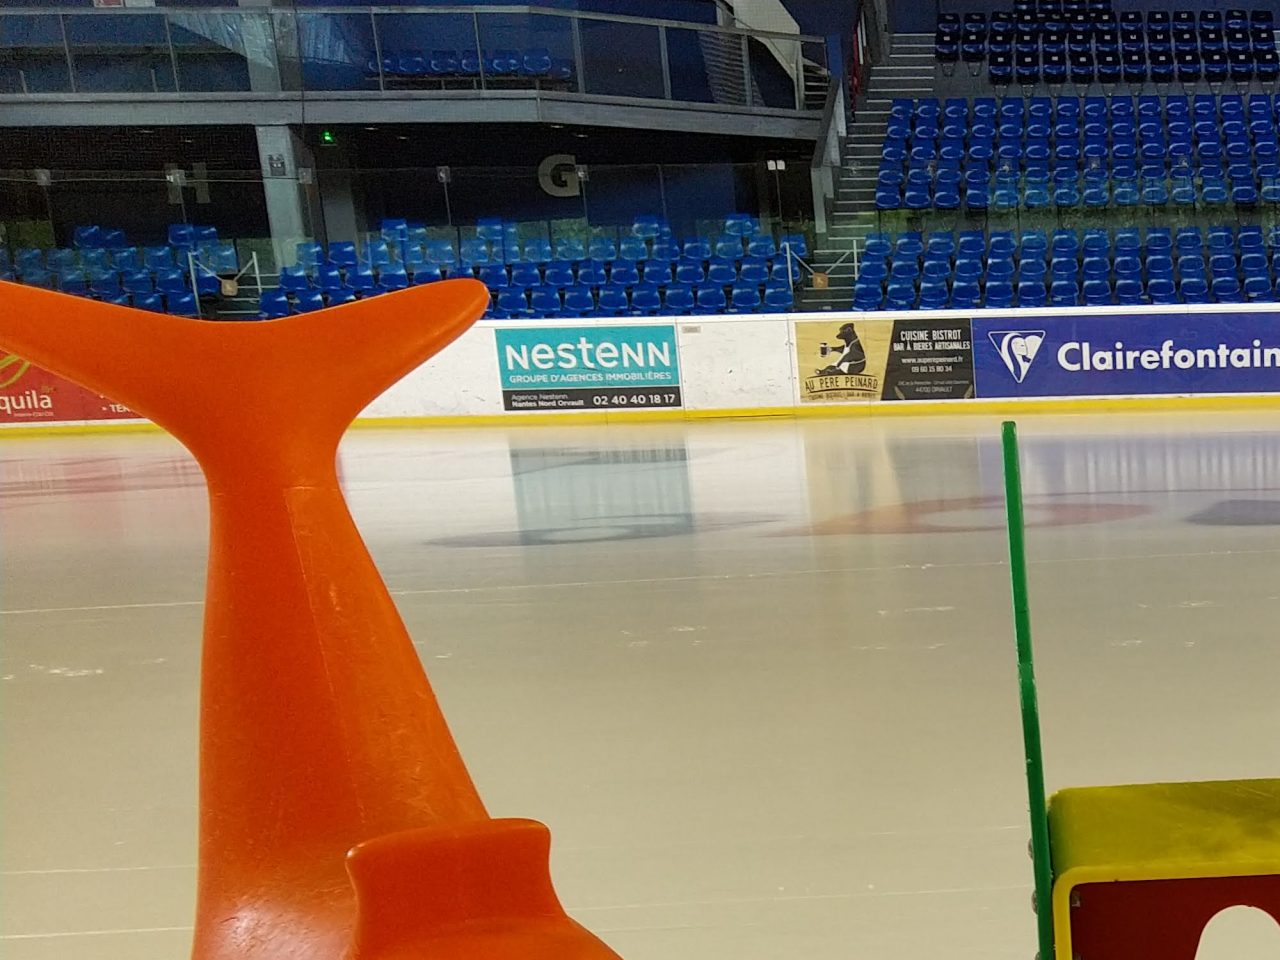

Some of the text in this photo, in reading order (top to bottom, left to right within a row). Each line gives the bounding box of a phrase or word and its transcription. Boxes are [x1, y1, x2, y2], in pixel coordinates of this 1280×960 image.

[538, 154, 580, 197] G
[900, 329, 962, 341] CUISINE BISTROT
[893, 342, 905, 351] BAR
[934, 341, 971, 350] ARTISANALES
[509, 371, 672, 384] GROUPE D'AGENCES IMMOBILIÈRES
[804, 380, 815, 391] AU
[845, 376, 879, 390] PEINARD
[0, 389, 52, 414] quila
[511, 394, 538, 402] Agence
[593, 393, 676, 406] 02 40 40 18 17
